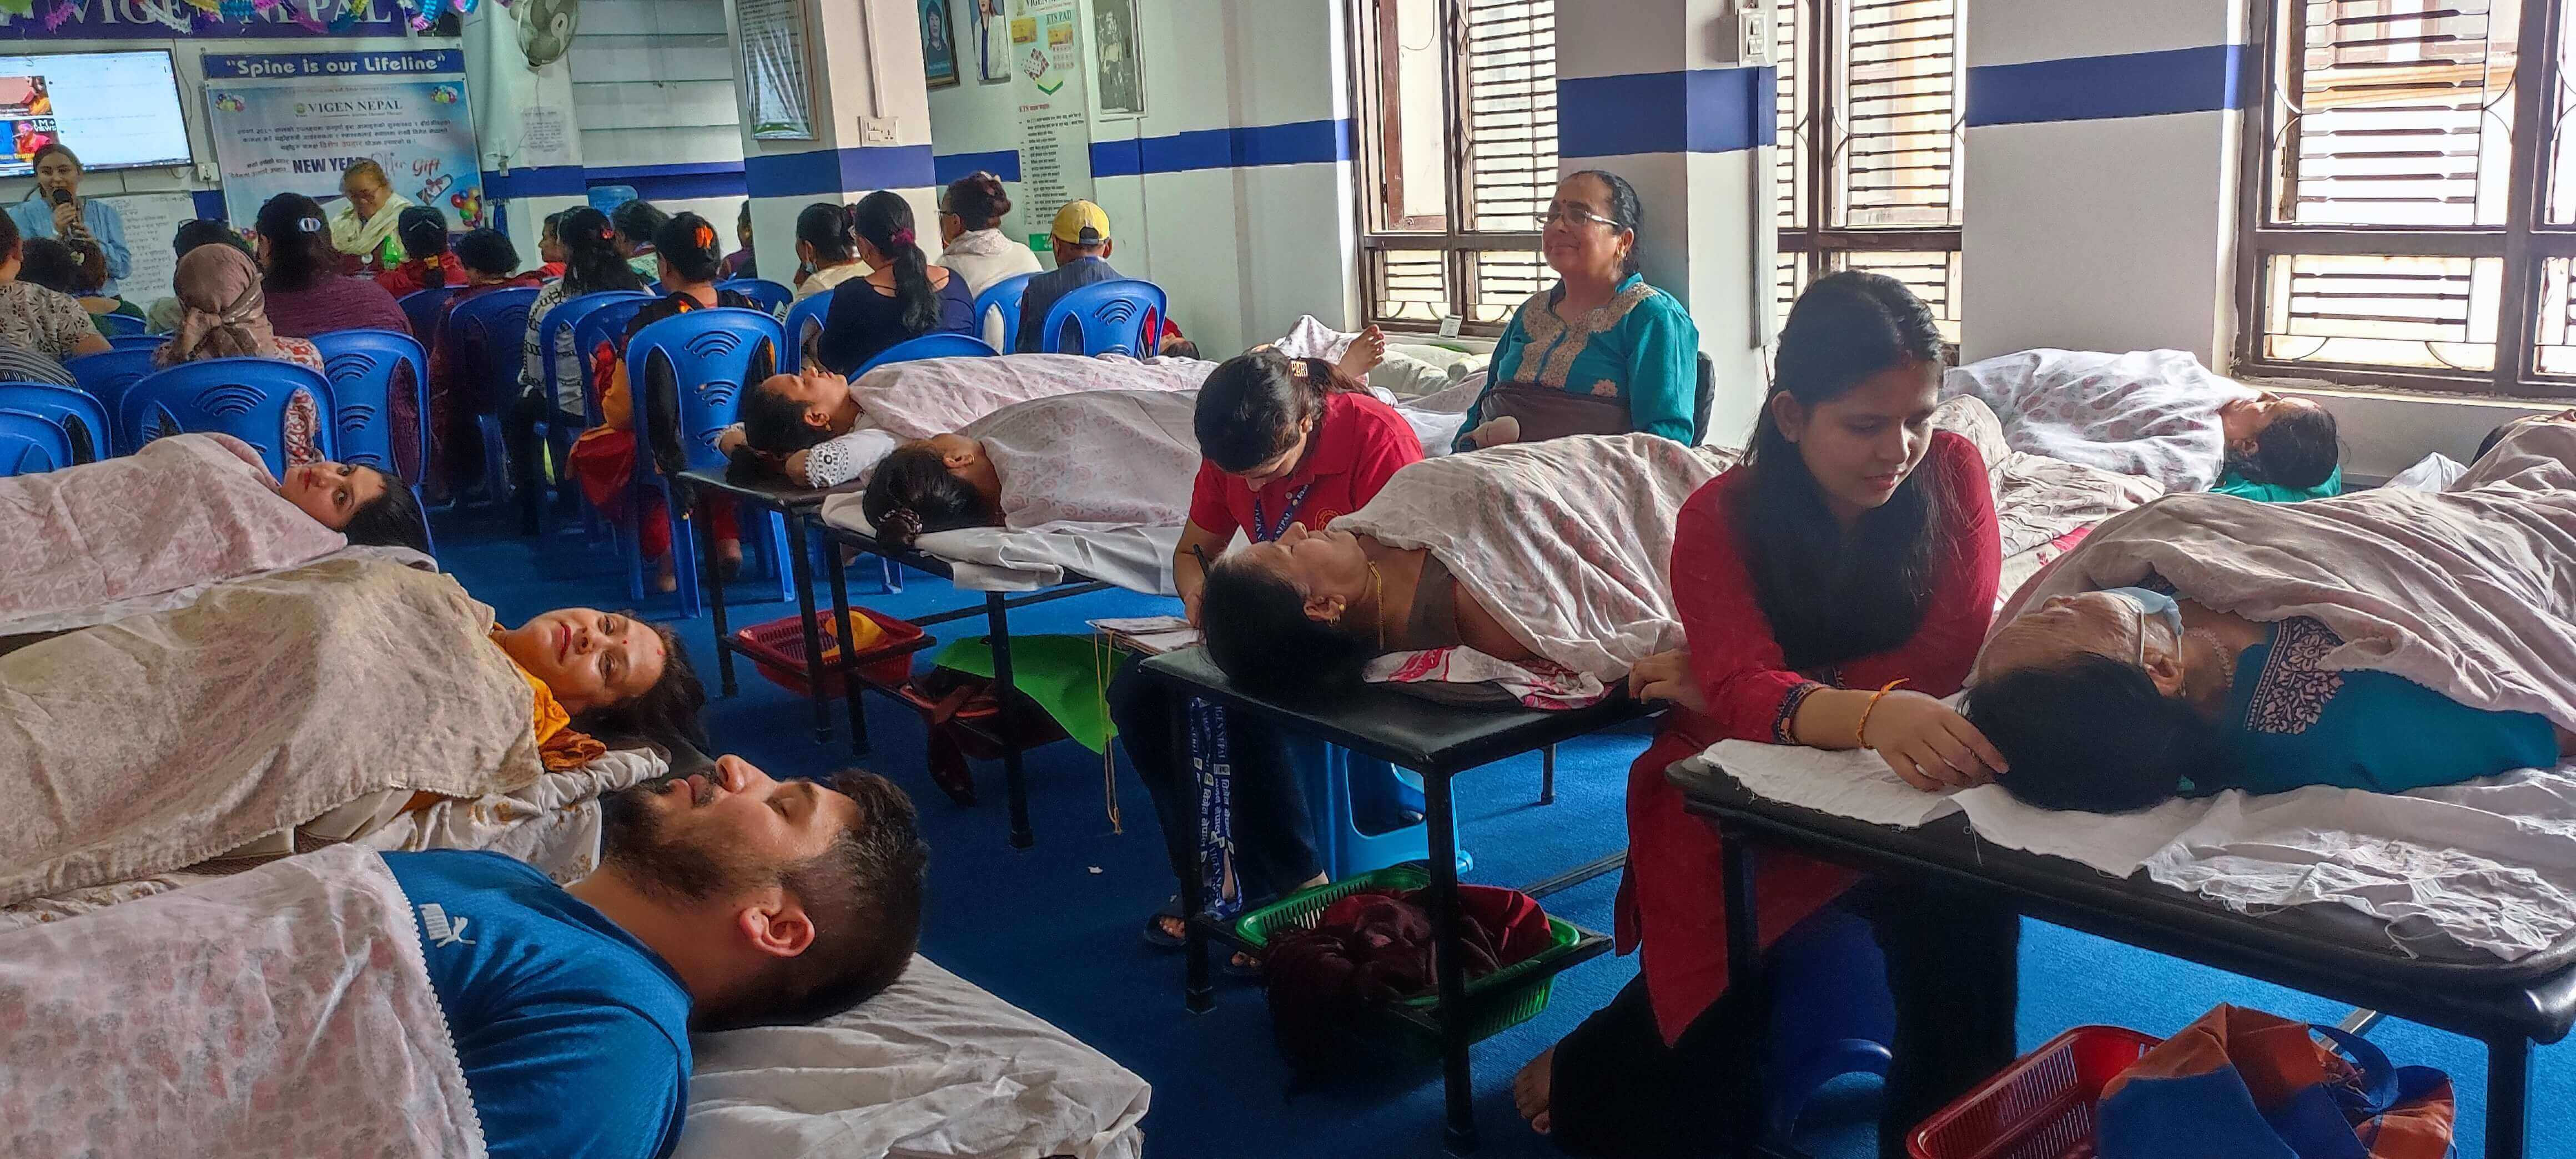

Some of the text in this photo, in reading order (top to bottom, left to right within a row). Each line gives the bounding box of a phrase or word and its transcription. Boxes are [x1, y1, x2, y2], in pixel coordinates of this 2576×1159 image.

[66, 0, 391, 24] VIGE EPAL
[303, 58, 320, 73] is
[326, 61, 358, 73] our
[309, 100, 402, 112] VIGEN NEPAL
[292, 158, 326, 174] NEW
[329, 157, 371, 172] YEA
[1215, 706, 1223, 728] IGEN
